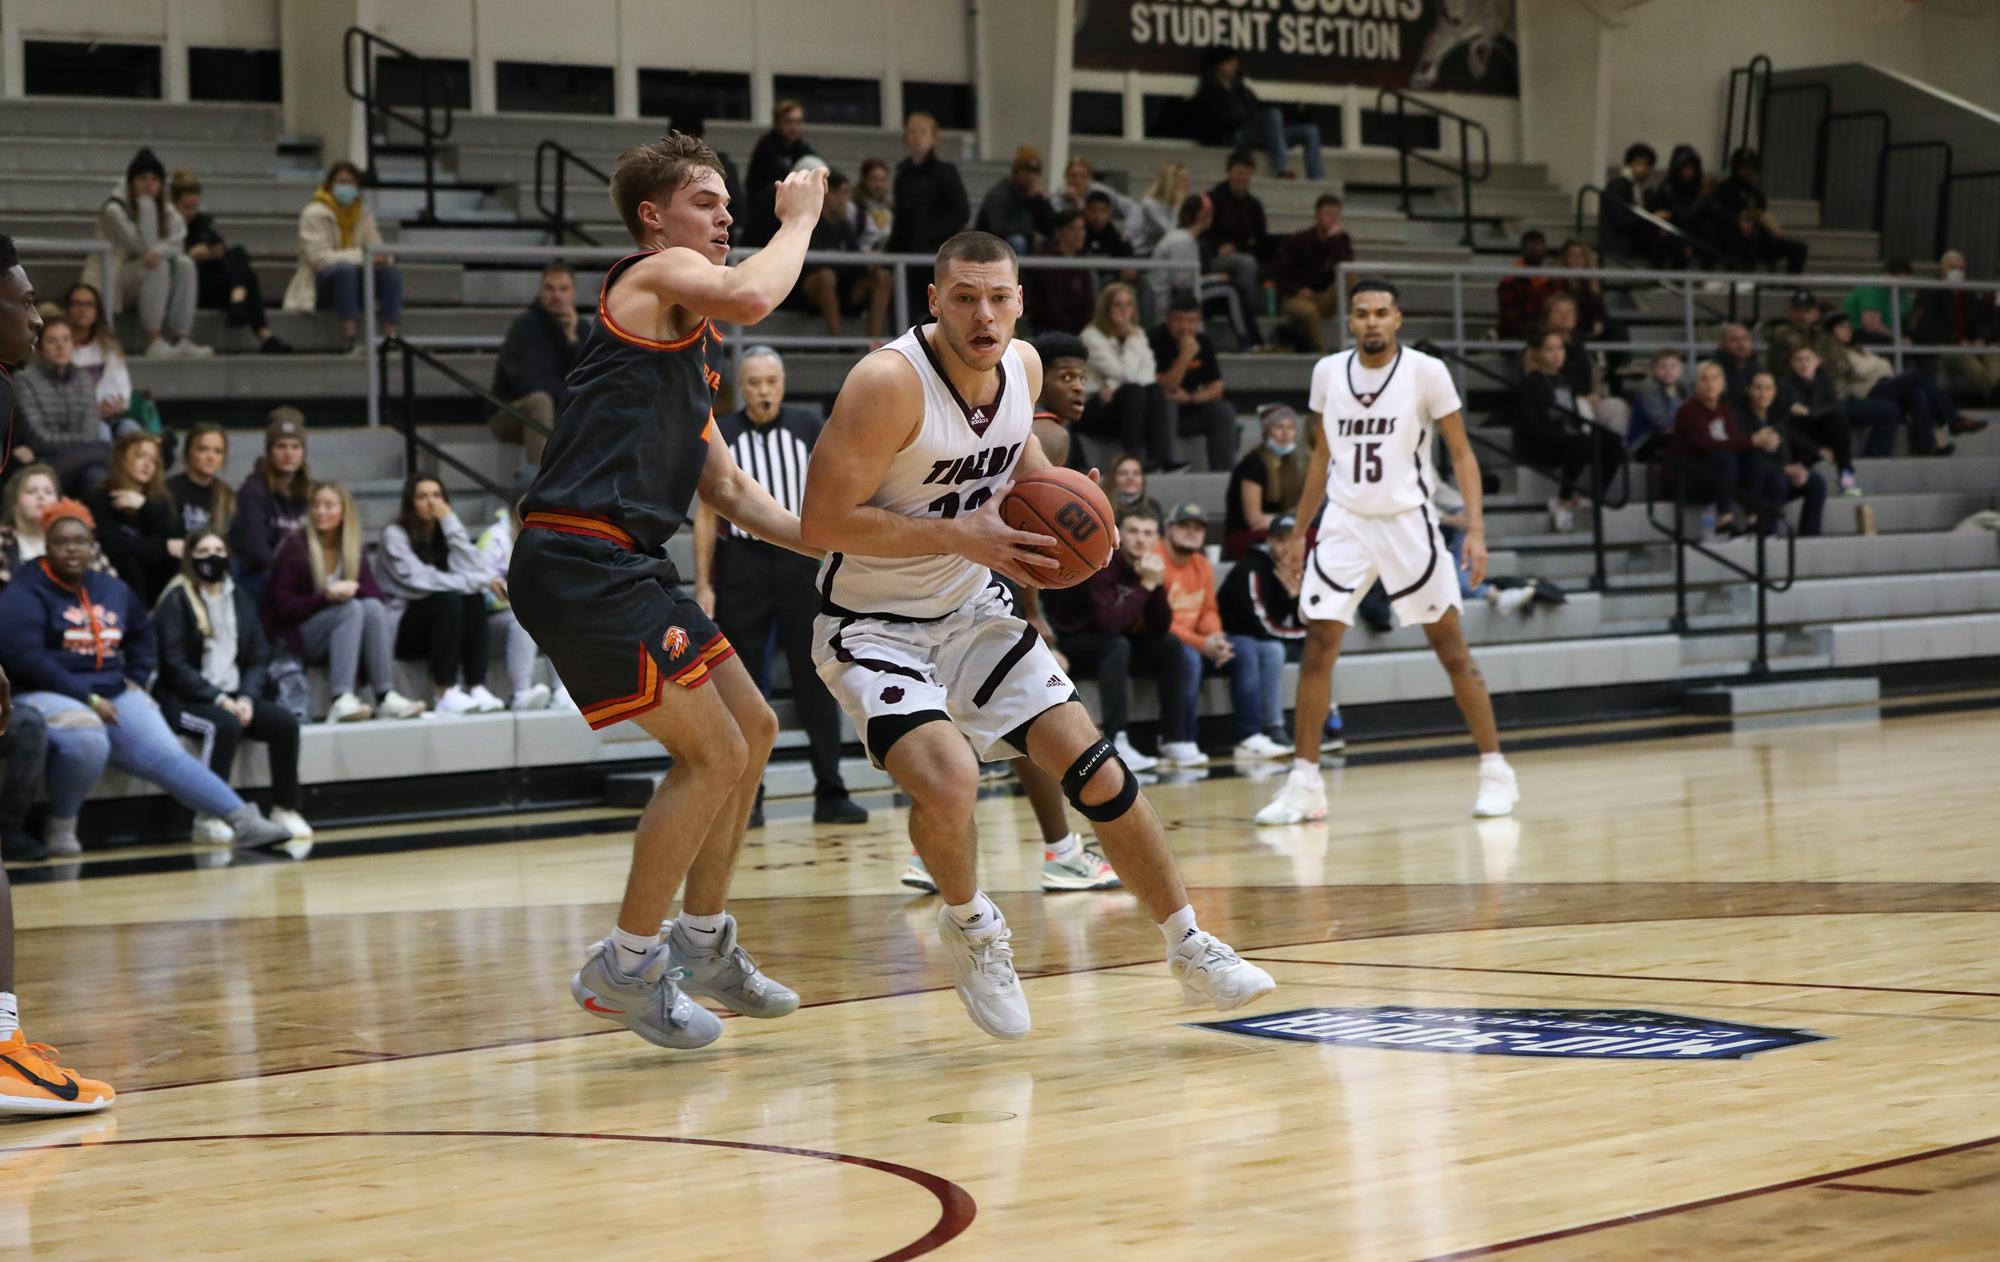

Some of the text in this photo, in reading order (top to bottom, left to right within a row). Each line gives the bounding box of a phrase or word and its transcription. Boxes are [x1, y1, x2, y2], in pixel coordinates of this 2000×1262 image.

[1130, 3, 1271, 51] STUDENT
[1278, 15, 1400, 60] SECTION
[1338, 417, 1398, 437] TIGERS
[922, 442, 1022, 485] TIGERS
[1353, 443, 1382, 484] 15
[1243, 1012, 1777, 1055] MID-SOUTH
[1368, 1011, 1743, 1037] CONFERENCE
